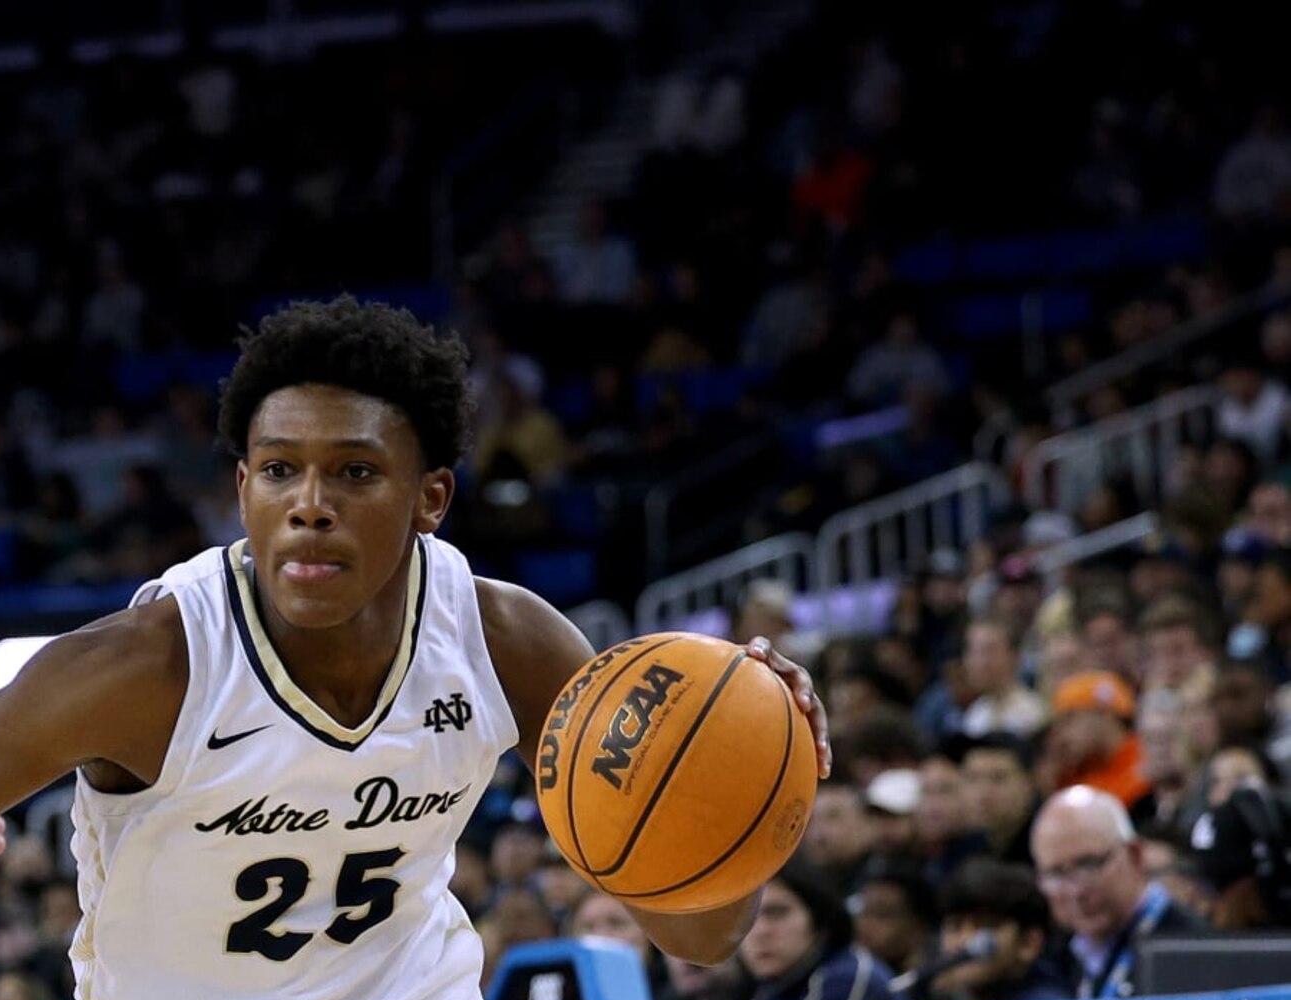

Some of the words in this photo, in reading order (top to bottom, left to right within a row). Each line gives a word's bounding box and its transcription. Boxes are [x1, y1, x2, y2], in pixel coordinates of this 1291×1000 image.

[591, 664, 685, 792] NCAA
[195, 795, 330, 836] Notre
[224, 844, 409, 962] 25
